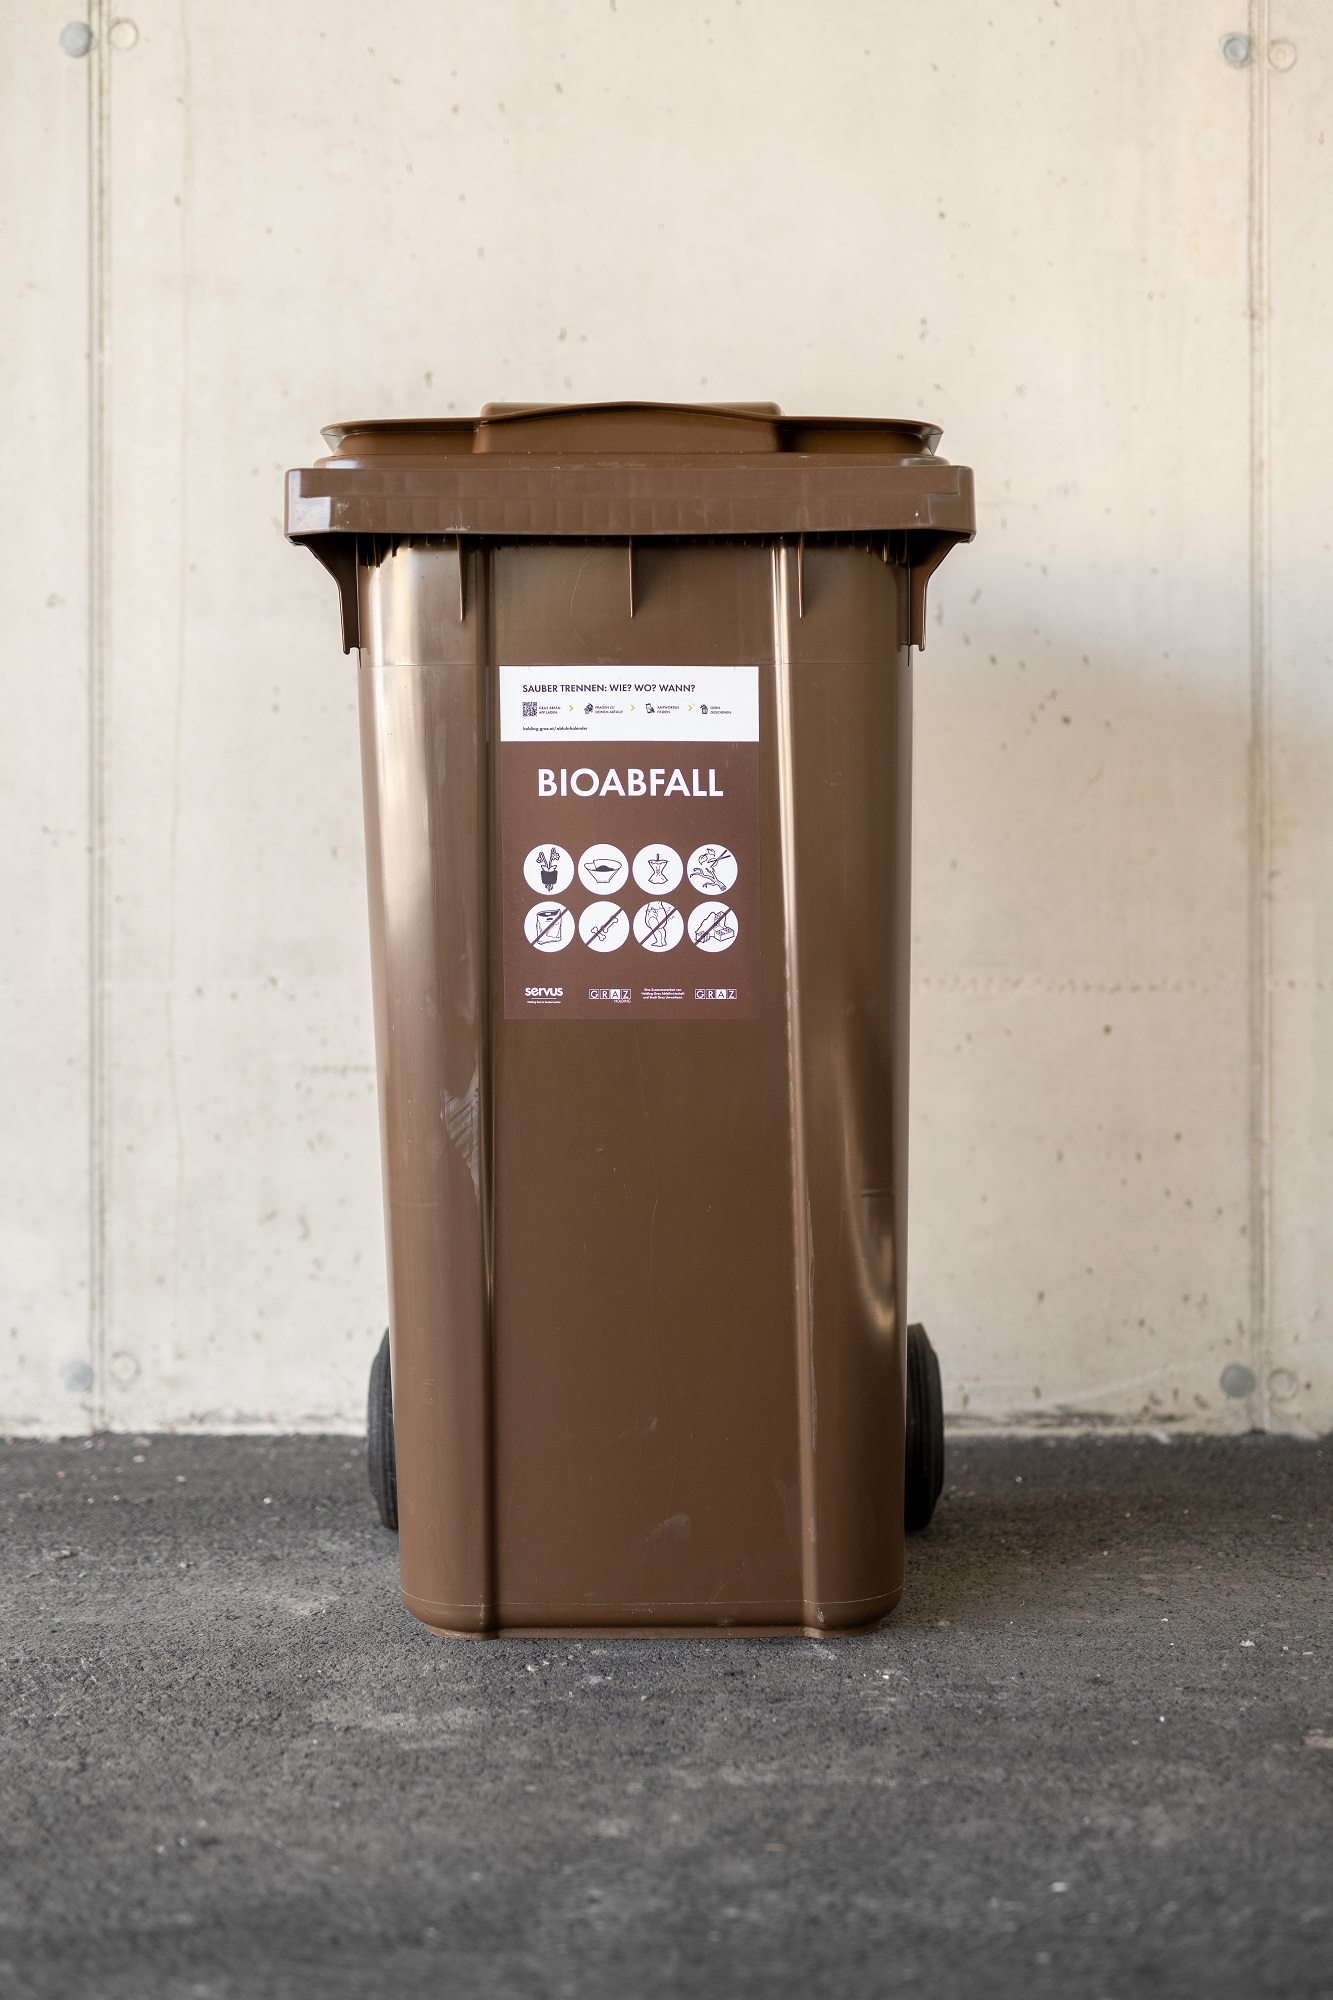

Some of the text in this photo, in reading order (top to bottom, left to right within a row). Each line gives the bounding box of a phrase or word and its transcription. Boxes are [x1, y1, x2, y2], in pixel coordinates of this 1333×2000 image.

[522, 684, 696, 693] SAUBER TRENNEN: WIE? WO? WANN?
[537, 768, 724, 797] BIOABFALL
[524, 987, 564, 997] servus
[588, 988, 632, 1000] GRAZ
[695, 988, 737, 1000] GRAZ
